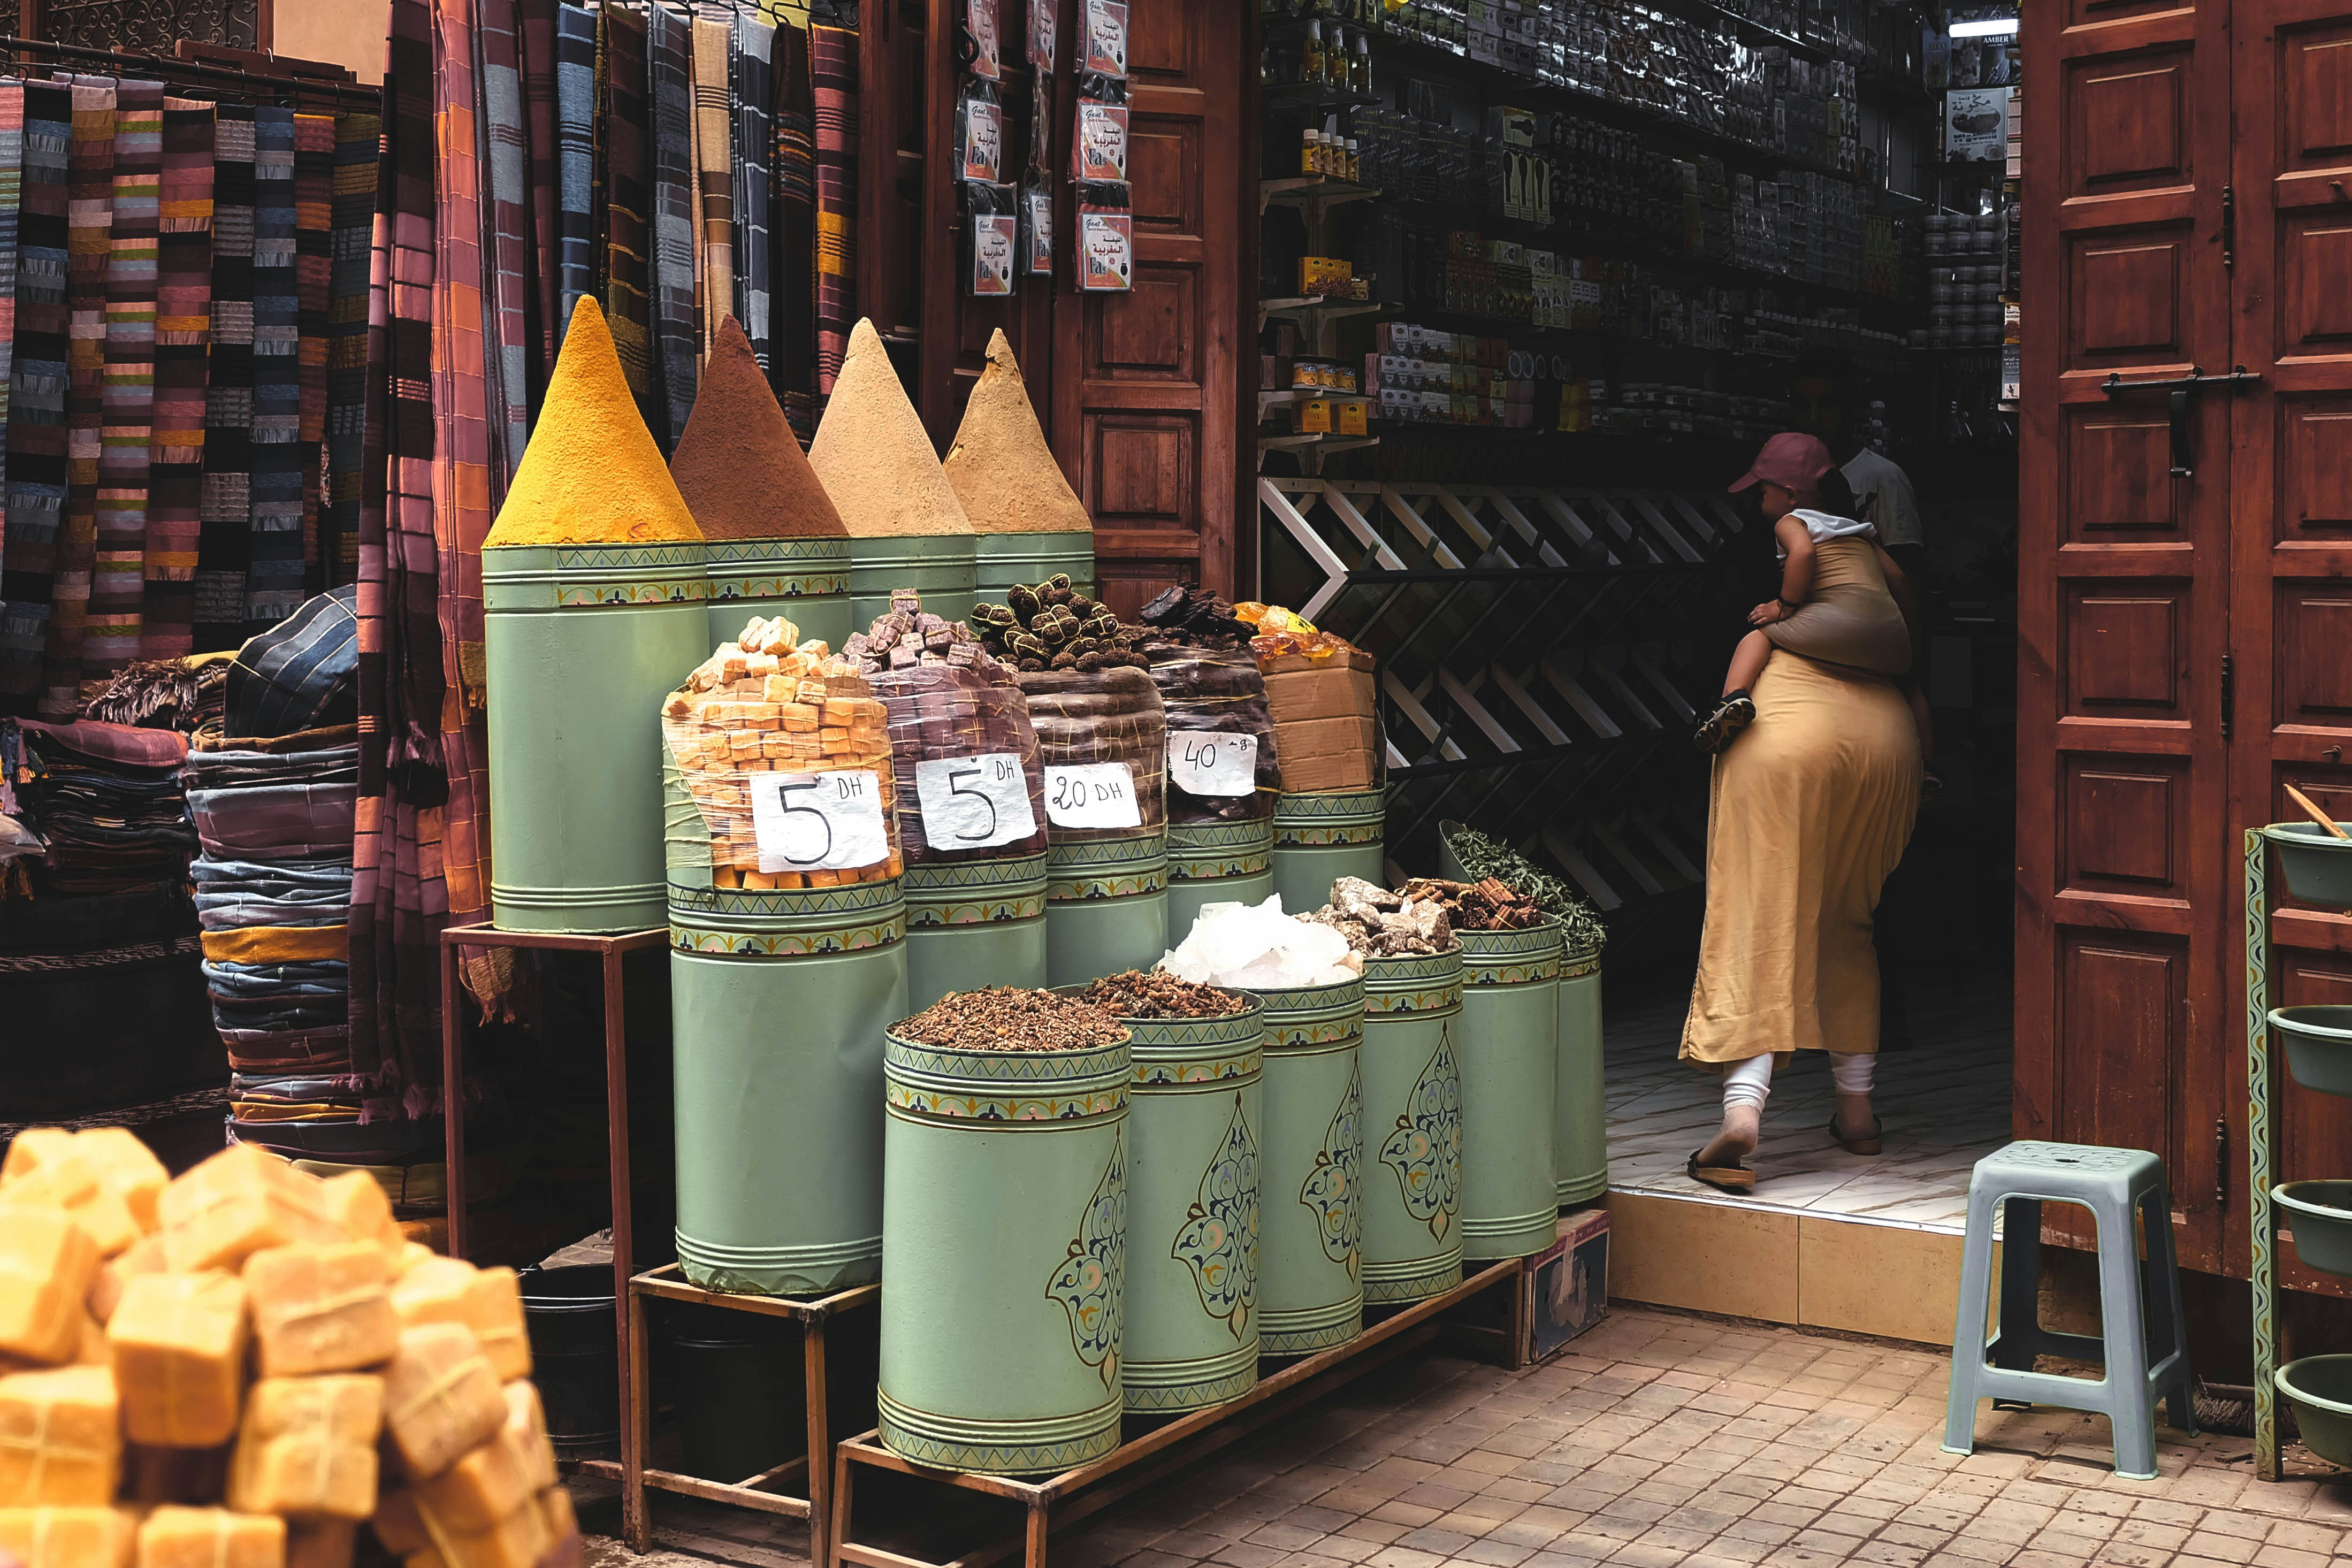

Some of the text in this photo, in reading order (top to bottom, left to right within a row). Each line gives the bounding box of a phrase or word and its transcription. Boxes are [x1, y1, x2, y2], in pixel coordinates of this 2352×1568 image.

[1095, 26, 1119, 41] المغربية
[1086, 110, 1101, 119] Gant
[1093, 135, 1121, 148] المغربية
[1086, 219, 1101, 229] Gant
[1103, 235, 1123, 244] الليفة
[983, 247, 1006, 259] المغربية
[1093, 244, 1124, 256] المغربية
[1089, 257, 1108, 274] Fas
[1185, 740, 1216, 770] 40
[1052, 776, 1122, 809] 20 DH
[949, 760, 1014, 841] 5 DH
[779, 777, 862, 865] 5 DH
